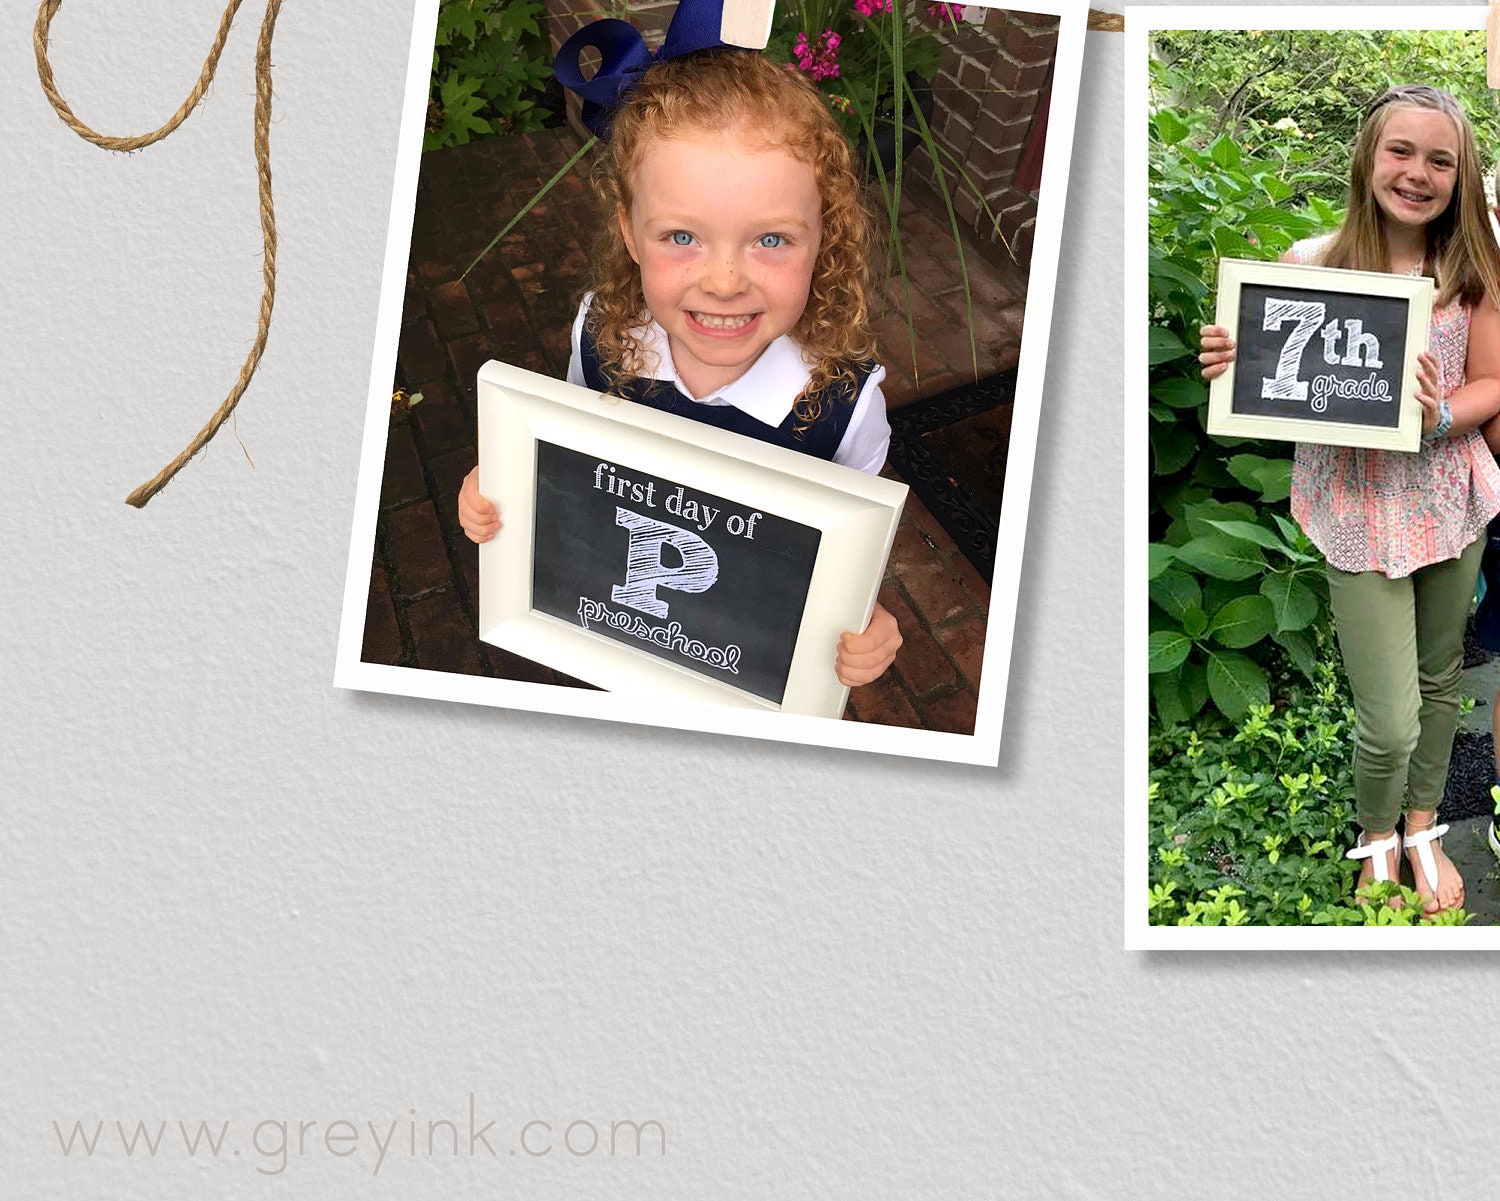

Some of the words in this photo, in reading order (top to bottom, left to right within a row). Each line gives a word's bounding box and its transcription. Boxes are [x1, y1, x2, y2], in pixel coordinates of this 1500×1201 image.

[1261, 297, 1383, 401] 7th
[1310, 372, 1392, 412] grade
[593, 463, 656, 508] first
[665, 487, 720, 531] day
[727, 512, 763, 540] of
[611, 507, 720, 619] P
[577, 596, 743, 674] preschool
